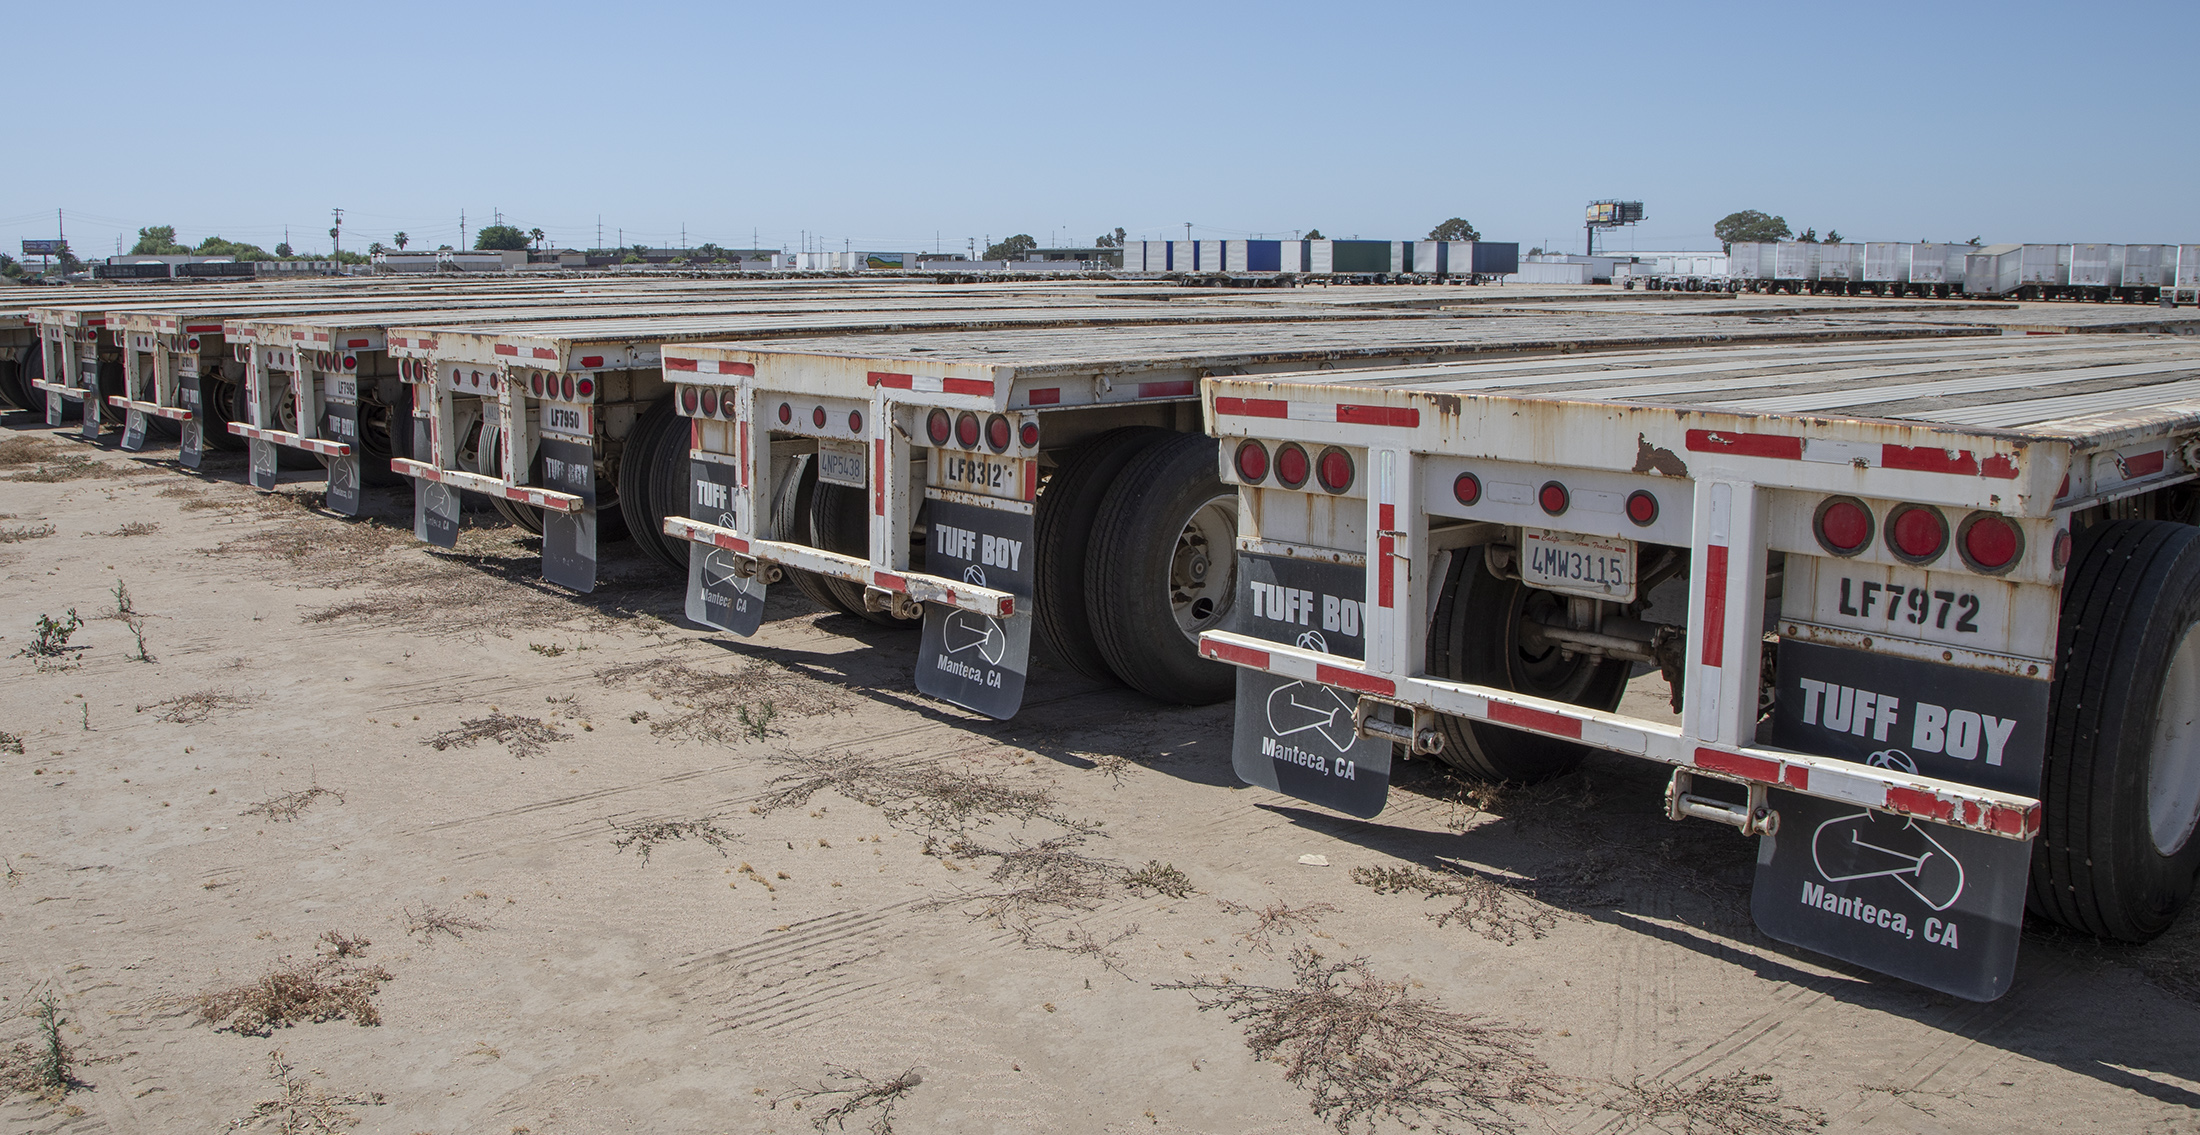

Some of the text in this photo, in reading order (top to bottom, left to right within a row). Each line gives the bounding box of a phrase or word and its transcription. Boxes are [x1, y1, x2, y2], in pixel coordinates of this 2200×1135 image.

[550, 408, 580, 430] LF7950
[821, 453, 861, 478] 4NP5438
[949, 457, 1002, 488] LF8312
[696, 479, 727, 510] TUFF
[935, 522, 1023, 573] TUFF BOY
[1592, 541, 1613, 551] Trailer
[1532, 546, 1622, 586] 4MW3115
[736, 597, 748, 613] CA
[1250, 580, 1314, 626] TUFF
[1838, 577, 1980, 633] LF7972
[937, 653, 1002, 690] Manteca, CA
[1800, 677, 2018, 767] TUFF BOY
[1261, 736, 1356, 781] Manteca, CA
[1800, 880, 1959, 950] Manteca, CA
